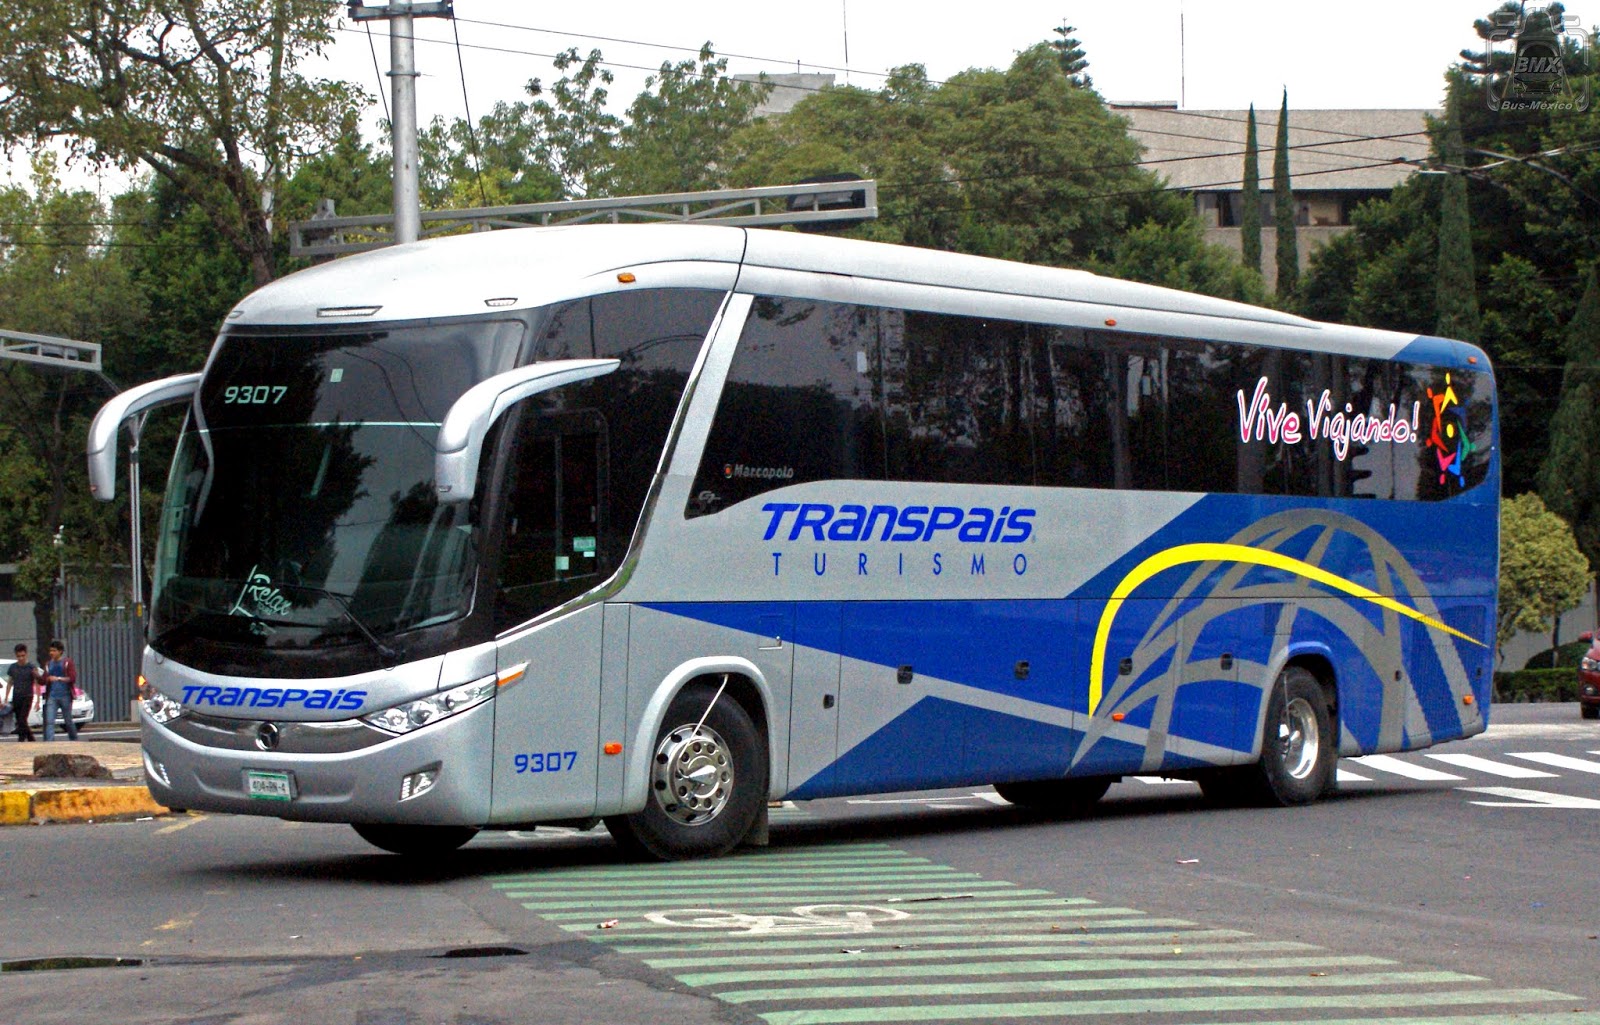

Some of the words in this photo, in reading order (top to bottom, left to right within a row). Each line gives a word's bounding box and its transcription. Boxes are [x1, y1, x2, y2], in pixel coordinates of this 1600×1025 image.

[224, 385, 288, 404] 9307
[1237, 376, 1302, 444] Vive
[1307, 389, 1420, 461] Viajando!
[734, 464, 795, 479] Marcopolo
[772, 552, 1027, 576] TURISMO
[514, 751, 578, 774] 9307
